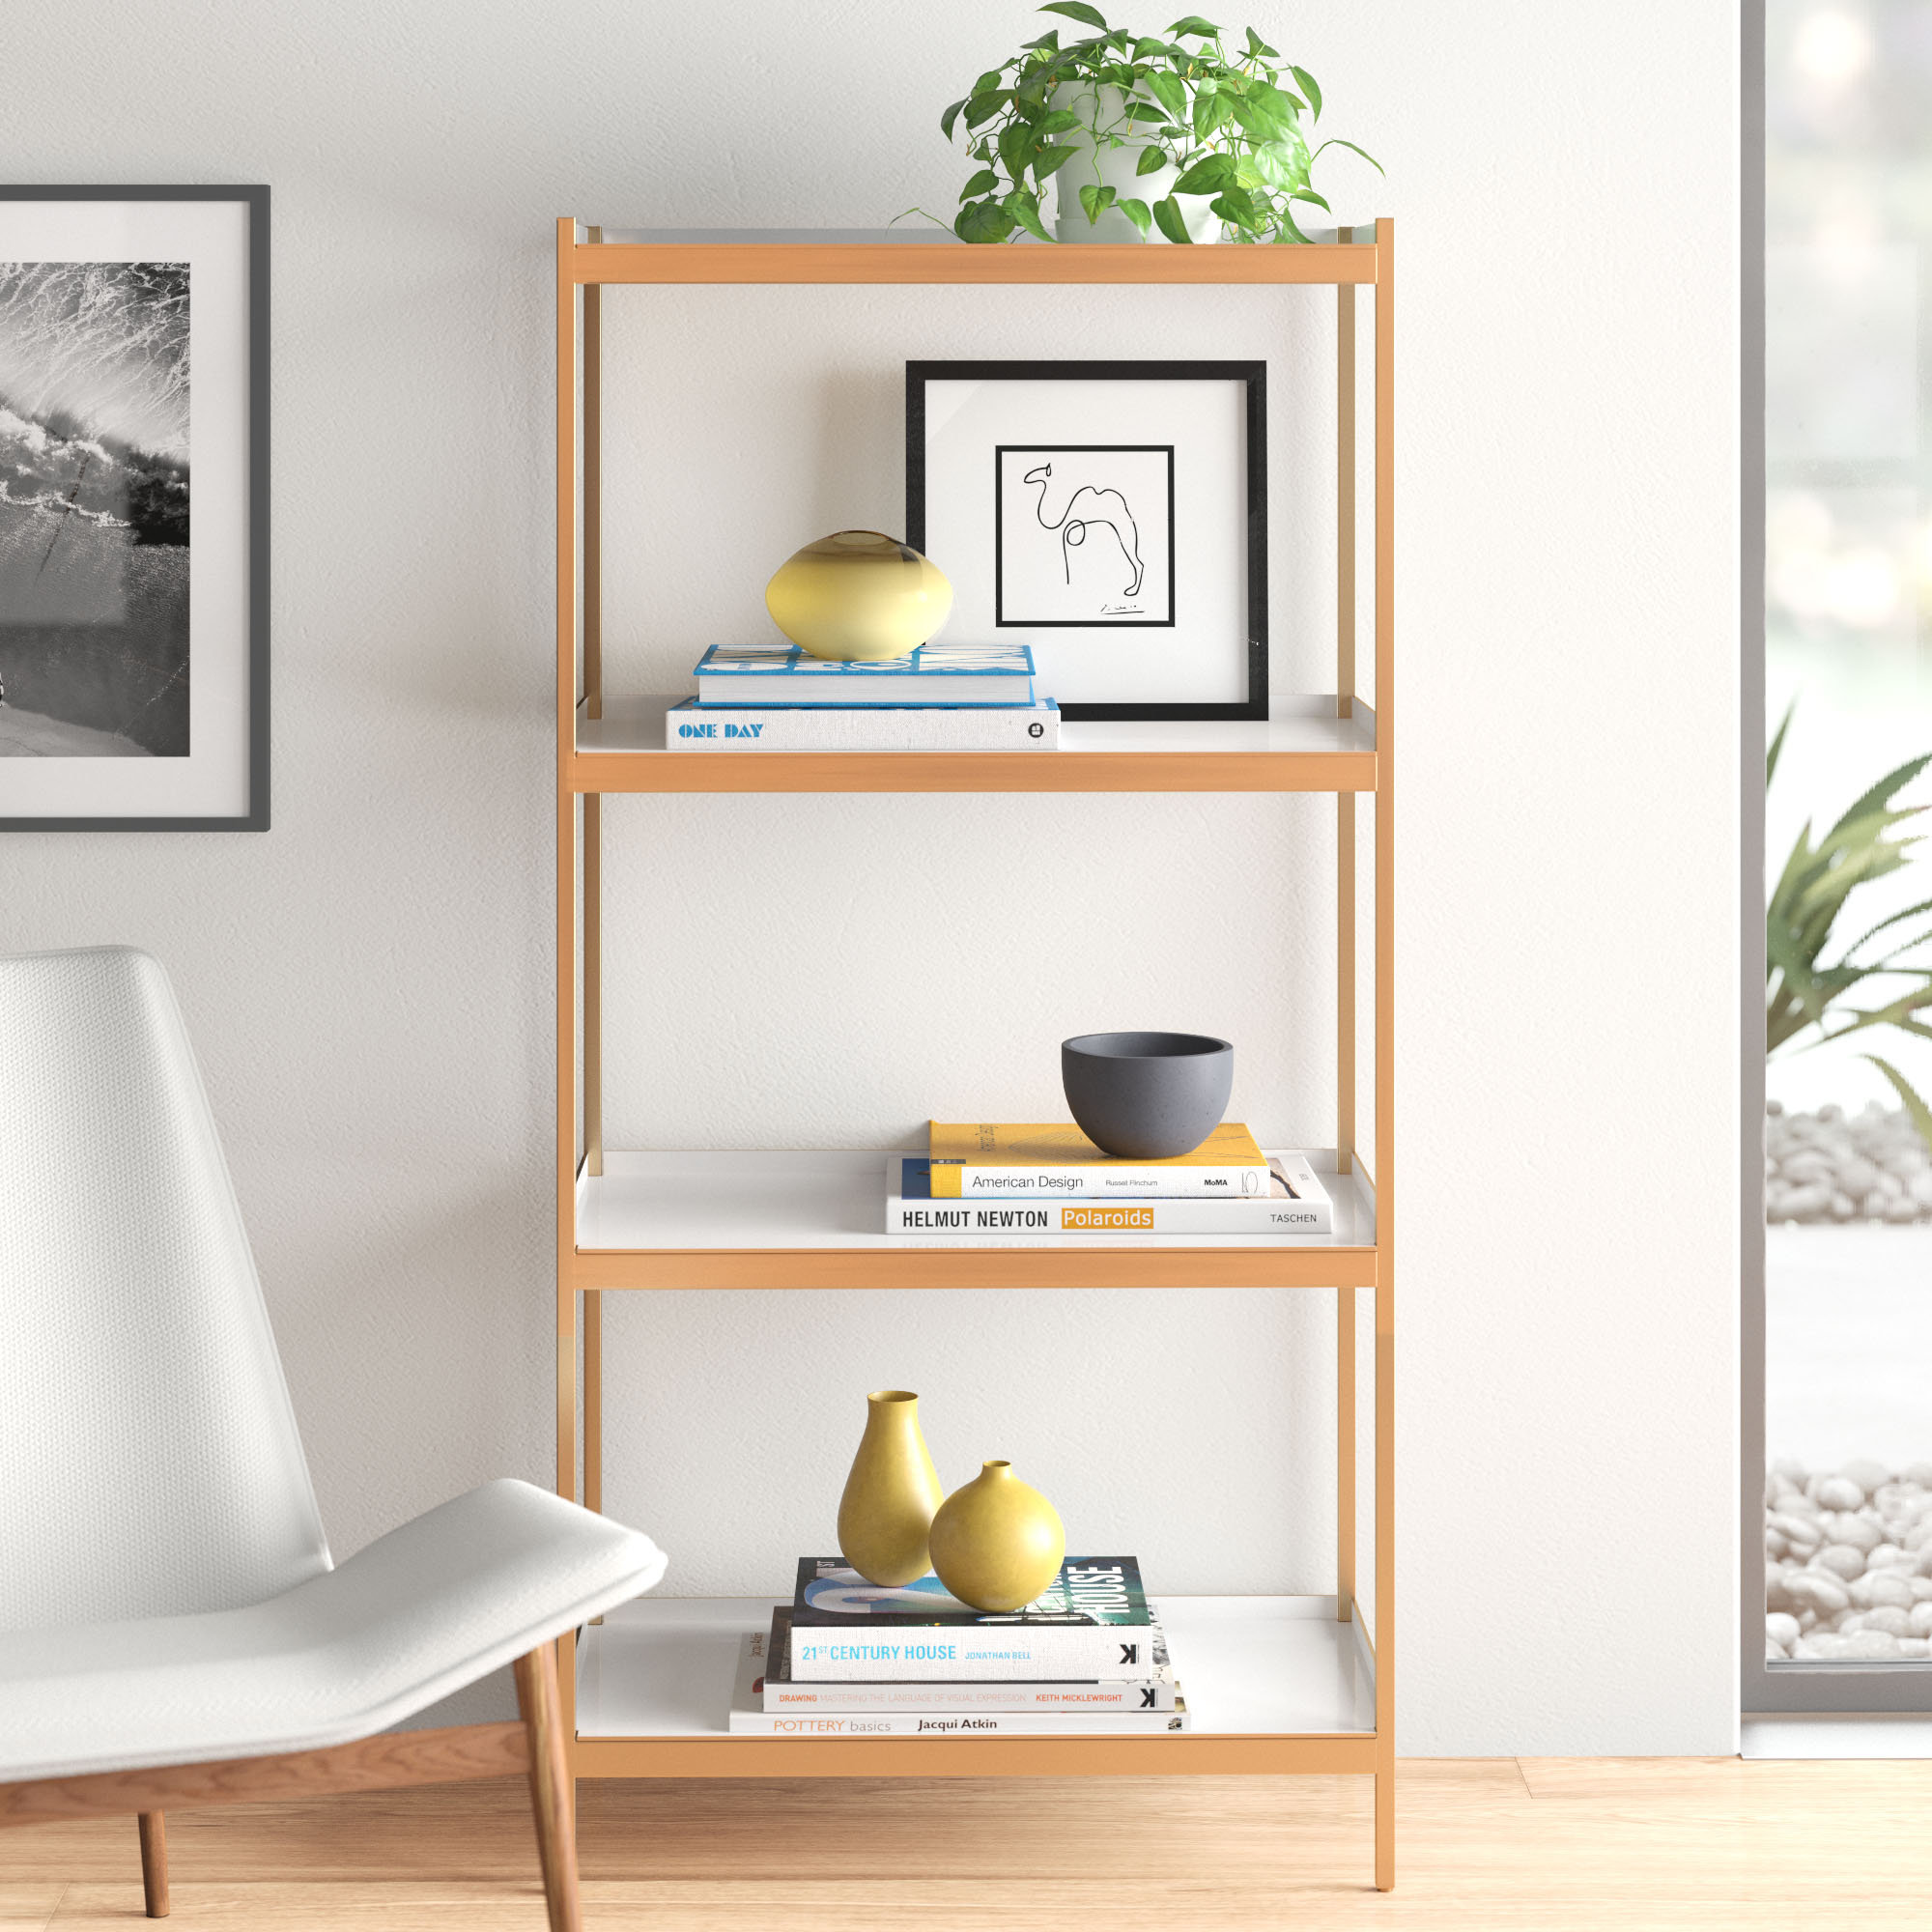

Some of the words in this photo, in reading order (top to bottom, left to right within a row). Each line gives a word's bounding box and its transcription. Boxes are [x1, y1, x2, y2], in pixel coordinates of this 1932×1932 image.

[678, 724, 718, 738] ONE
[724, 724, 764, 738] DAY
[972, 1176, 1035, 1188] American
[1038, 1176, 1084, 1190] Design
[903, 1210, 971, 1228] HELMUT
[978, 1210, 1048, 1228] NEWTON
[1064, 1210, 1151, 1226] Polaroids
[1270, 1214, 1317, 1223] TASCHEN
[1066, 1566, 1130, 1613] HOUSE
[830, 1645, 900, 1661] CENTURY
[904, 1645, 956, 1661] HOUSE
[964, 1651, 1010, 1660] JONATHAN
[1011, 1651, 1032, 1660] BELL
[779, 1693, 817, 1702] DRAWING
[869, 1693, 886, 1702] THE
[1036, 1693, 1060, 1702] KEITH
[1062, 1693, 1123, 1702] MICKLEWRIGHT
[774, 1719, 845, 1732] POTTERY
[850, 1719, 891, 1732] basics
[918, 1719, 958, 1732] Jacqui
[961, 1719, 998, 1729] Atkin
